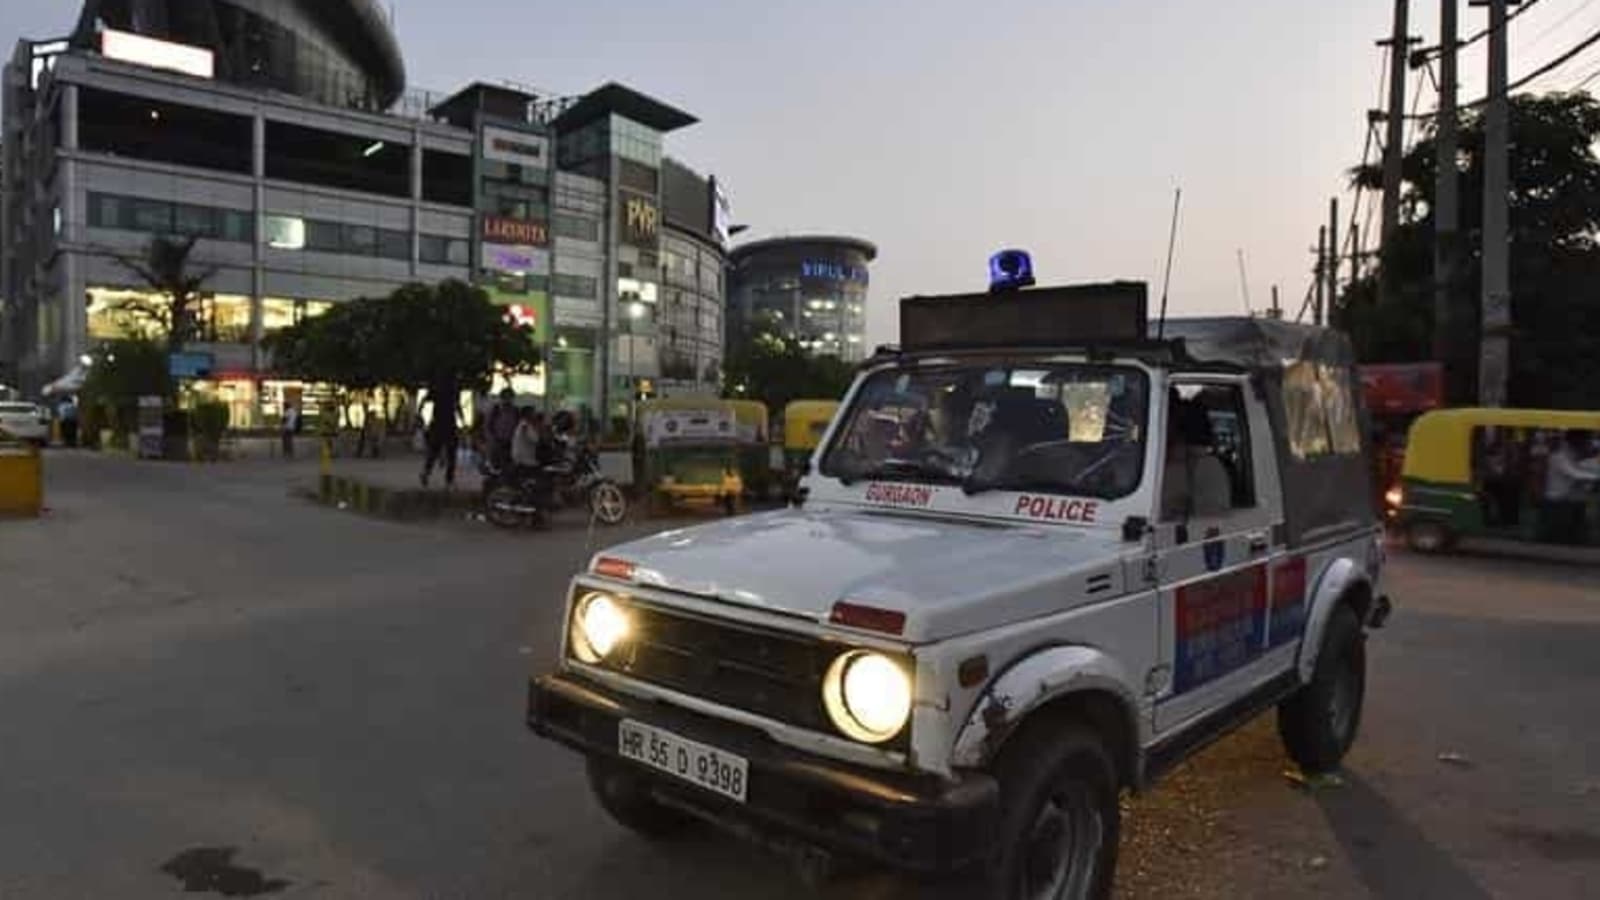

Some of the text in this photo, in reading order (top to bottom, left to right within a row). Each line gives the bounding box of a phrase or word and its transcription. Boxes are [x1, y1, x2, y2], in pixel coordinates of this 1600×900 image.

[627, 198, 657, 238] PVR
[865, 483, 1098, 522] GURGAON POLICE
[621, 729, 743, 795] HR 55 D 9398
